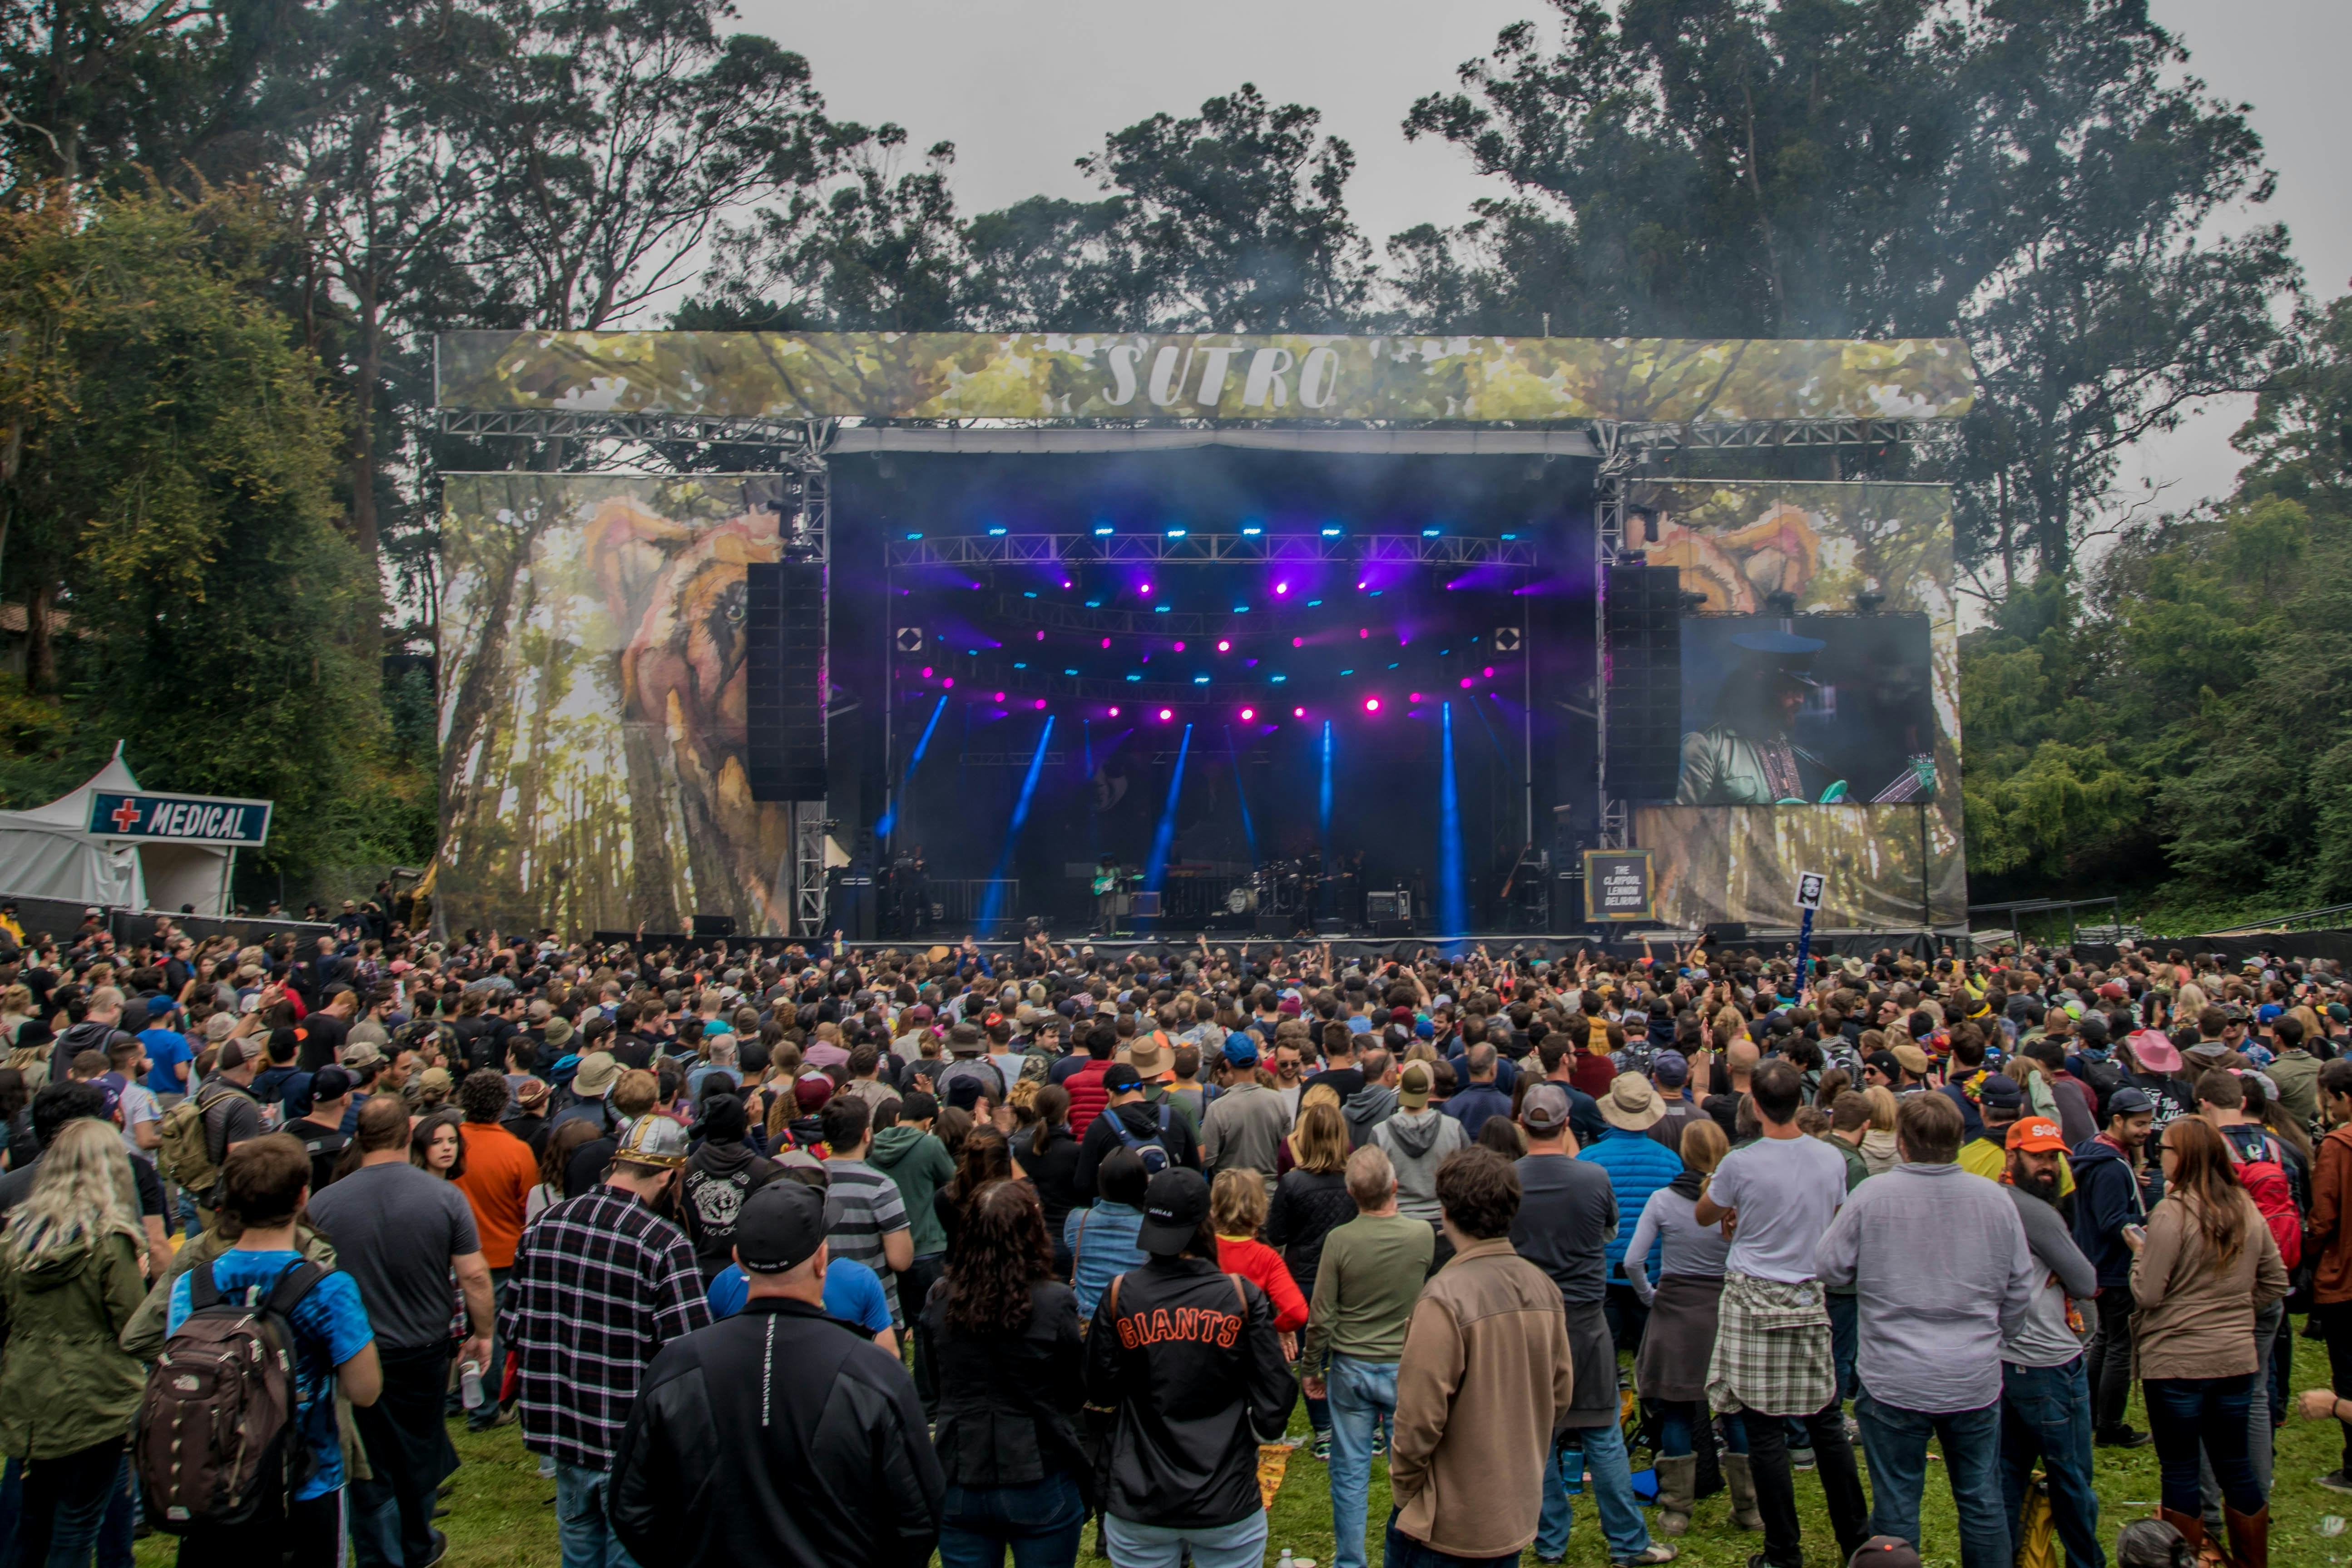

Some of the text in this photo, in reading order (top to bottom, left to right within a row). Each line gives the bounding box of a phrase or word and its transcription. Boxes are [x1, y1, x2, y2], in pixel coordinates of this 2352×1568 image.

[1102, 346, 1339, 408] SUTRO
[147, 802, 246, 839] MEDICAL
[1603, 876, 1642, 885] CLAYPOOL
[1614, 866, 1630, 875] THE
[1117, 1307, 1242, 1349] GIANTS
